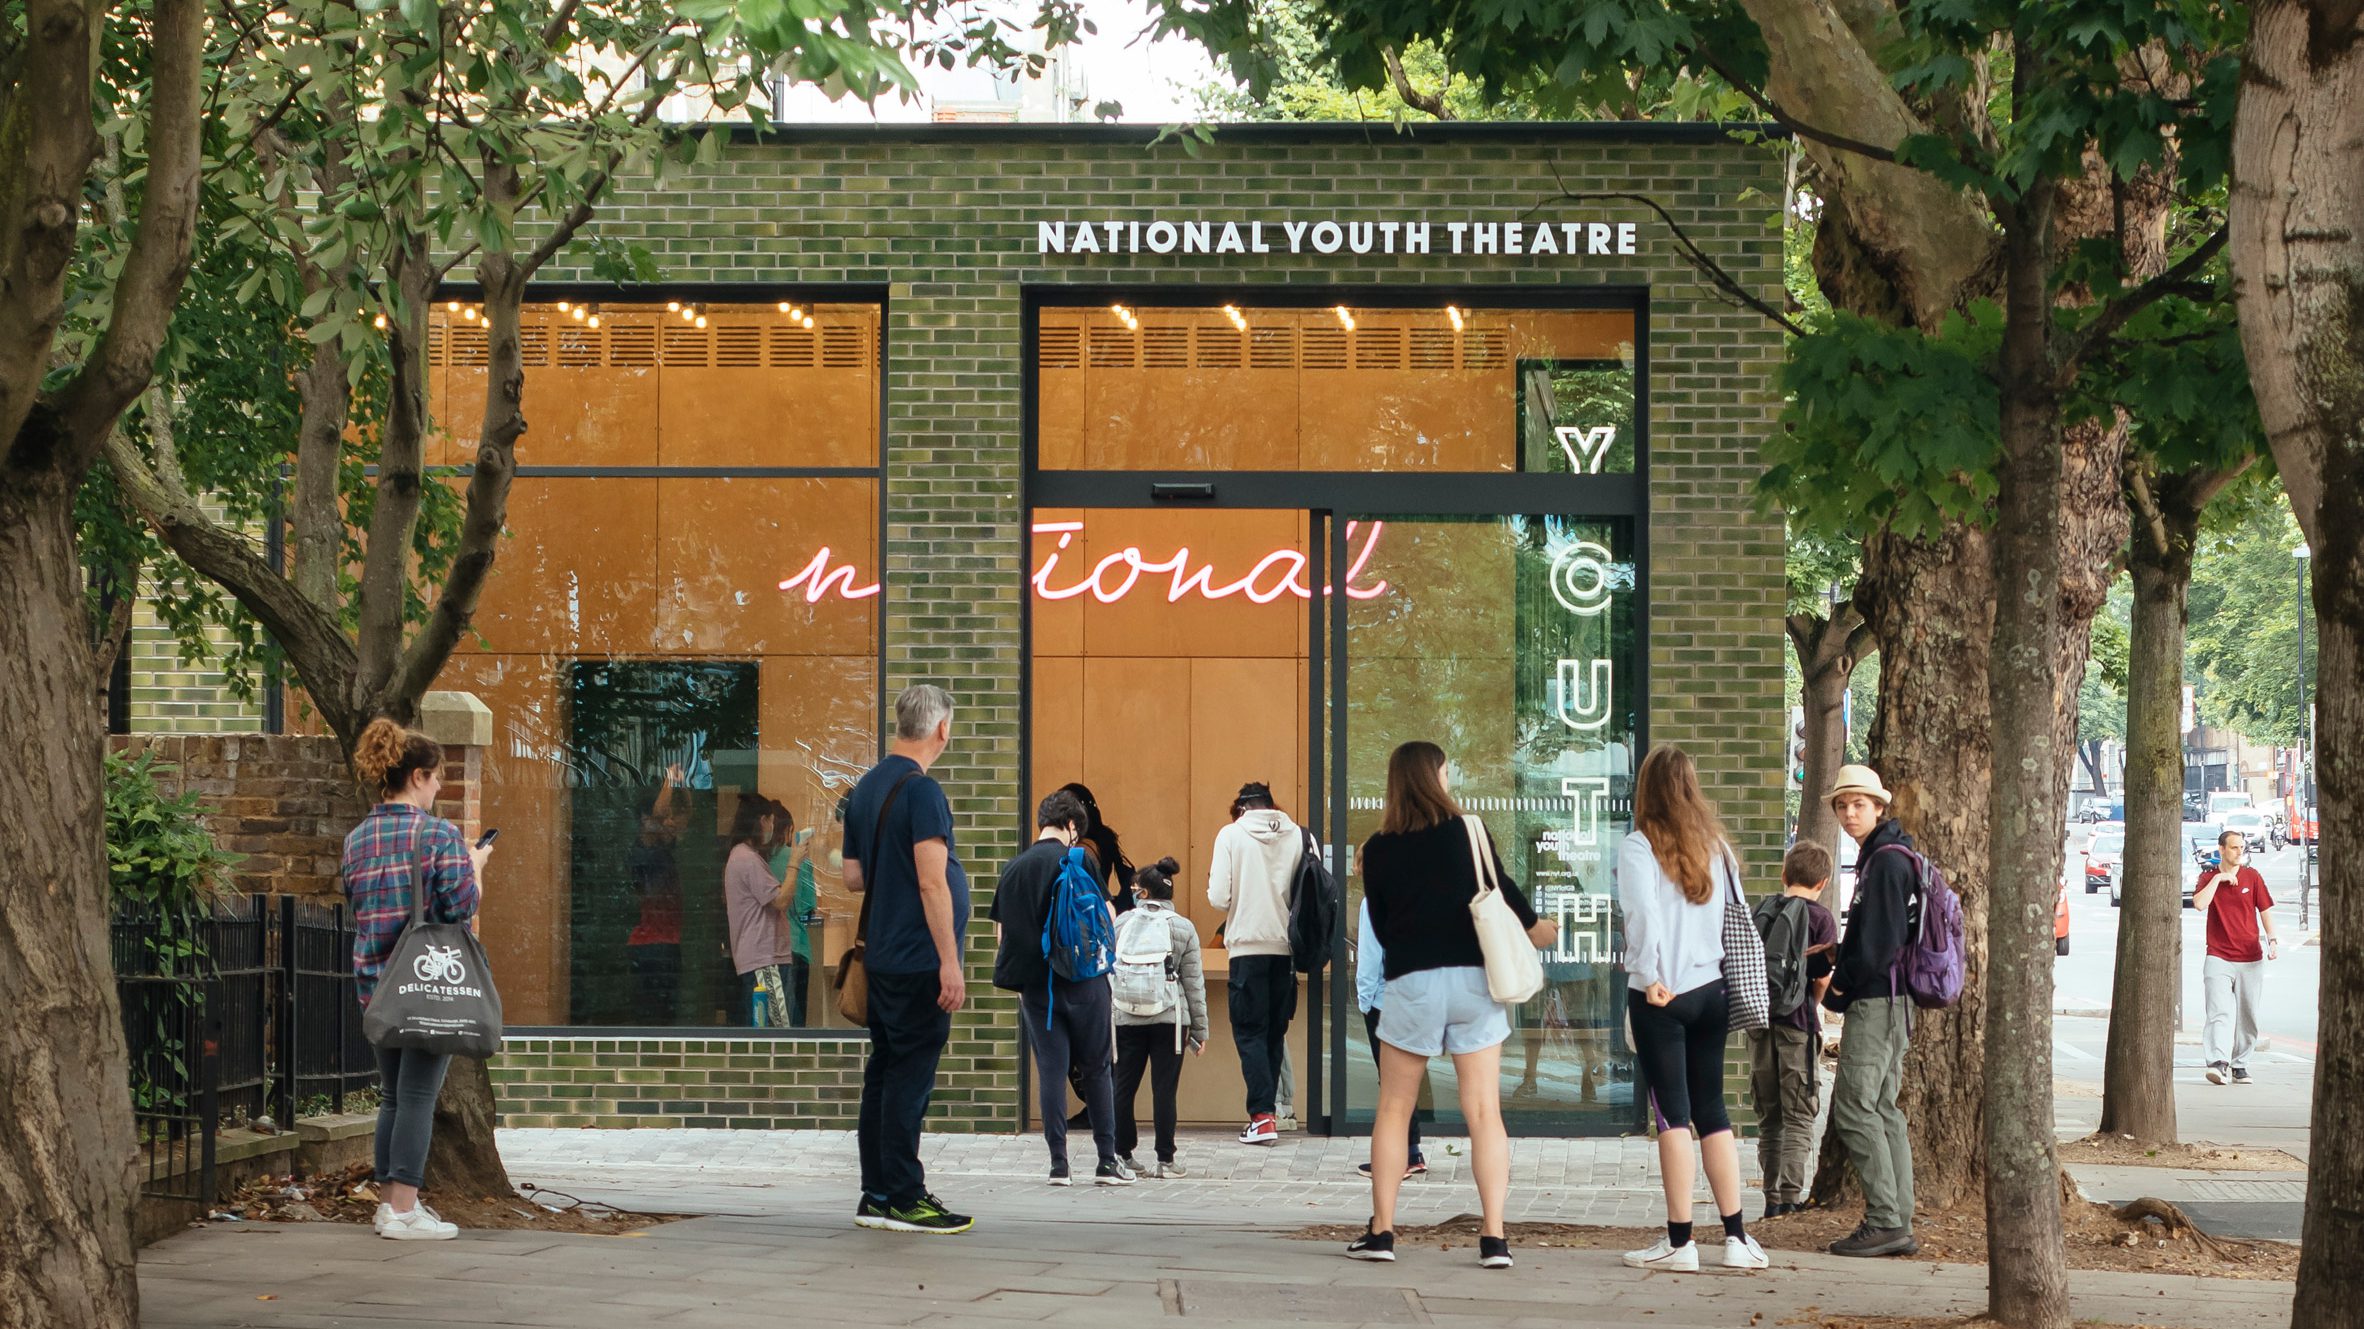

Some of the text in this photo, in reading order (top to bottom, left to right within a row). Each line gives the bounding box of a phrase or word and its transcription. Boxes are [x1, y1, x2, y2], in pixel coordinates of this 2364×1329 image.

[1038, 220, 1637, 255] NATIONAL YOUTH THEATRE
[1535, 840, 1570, 853] youth
[398, 983, 482, 998] DELICATESSEN
